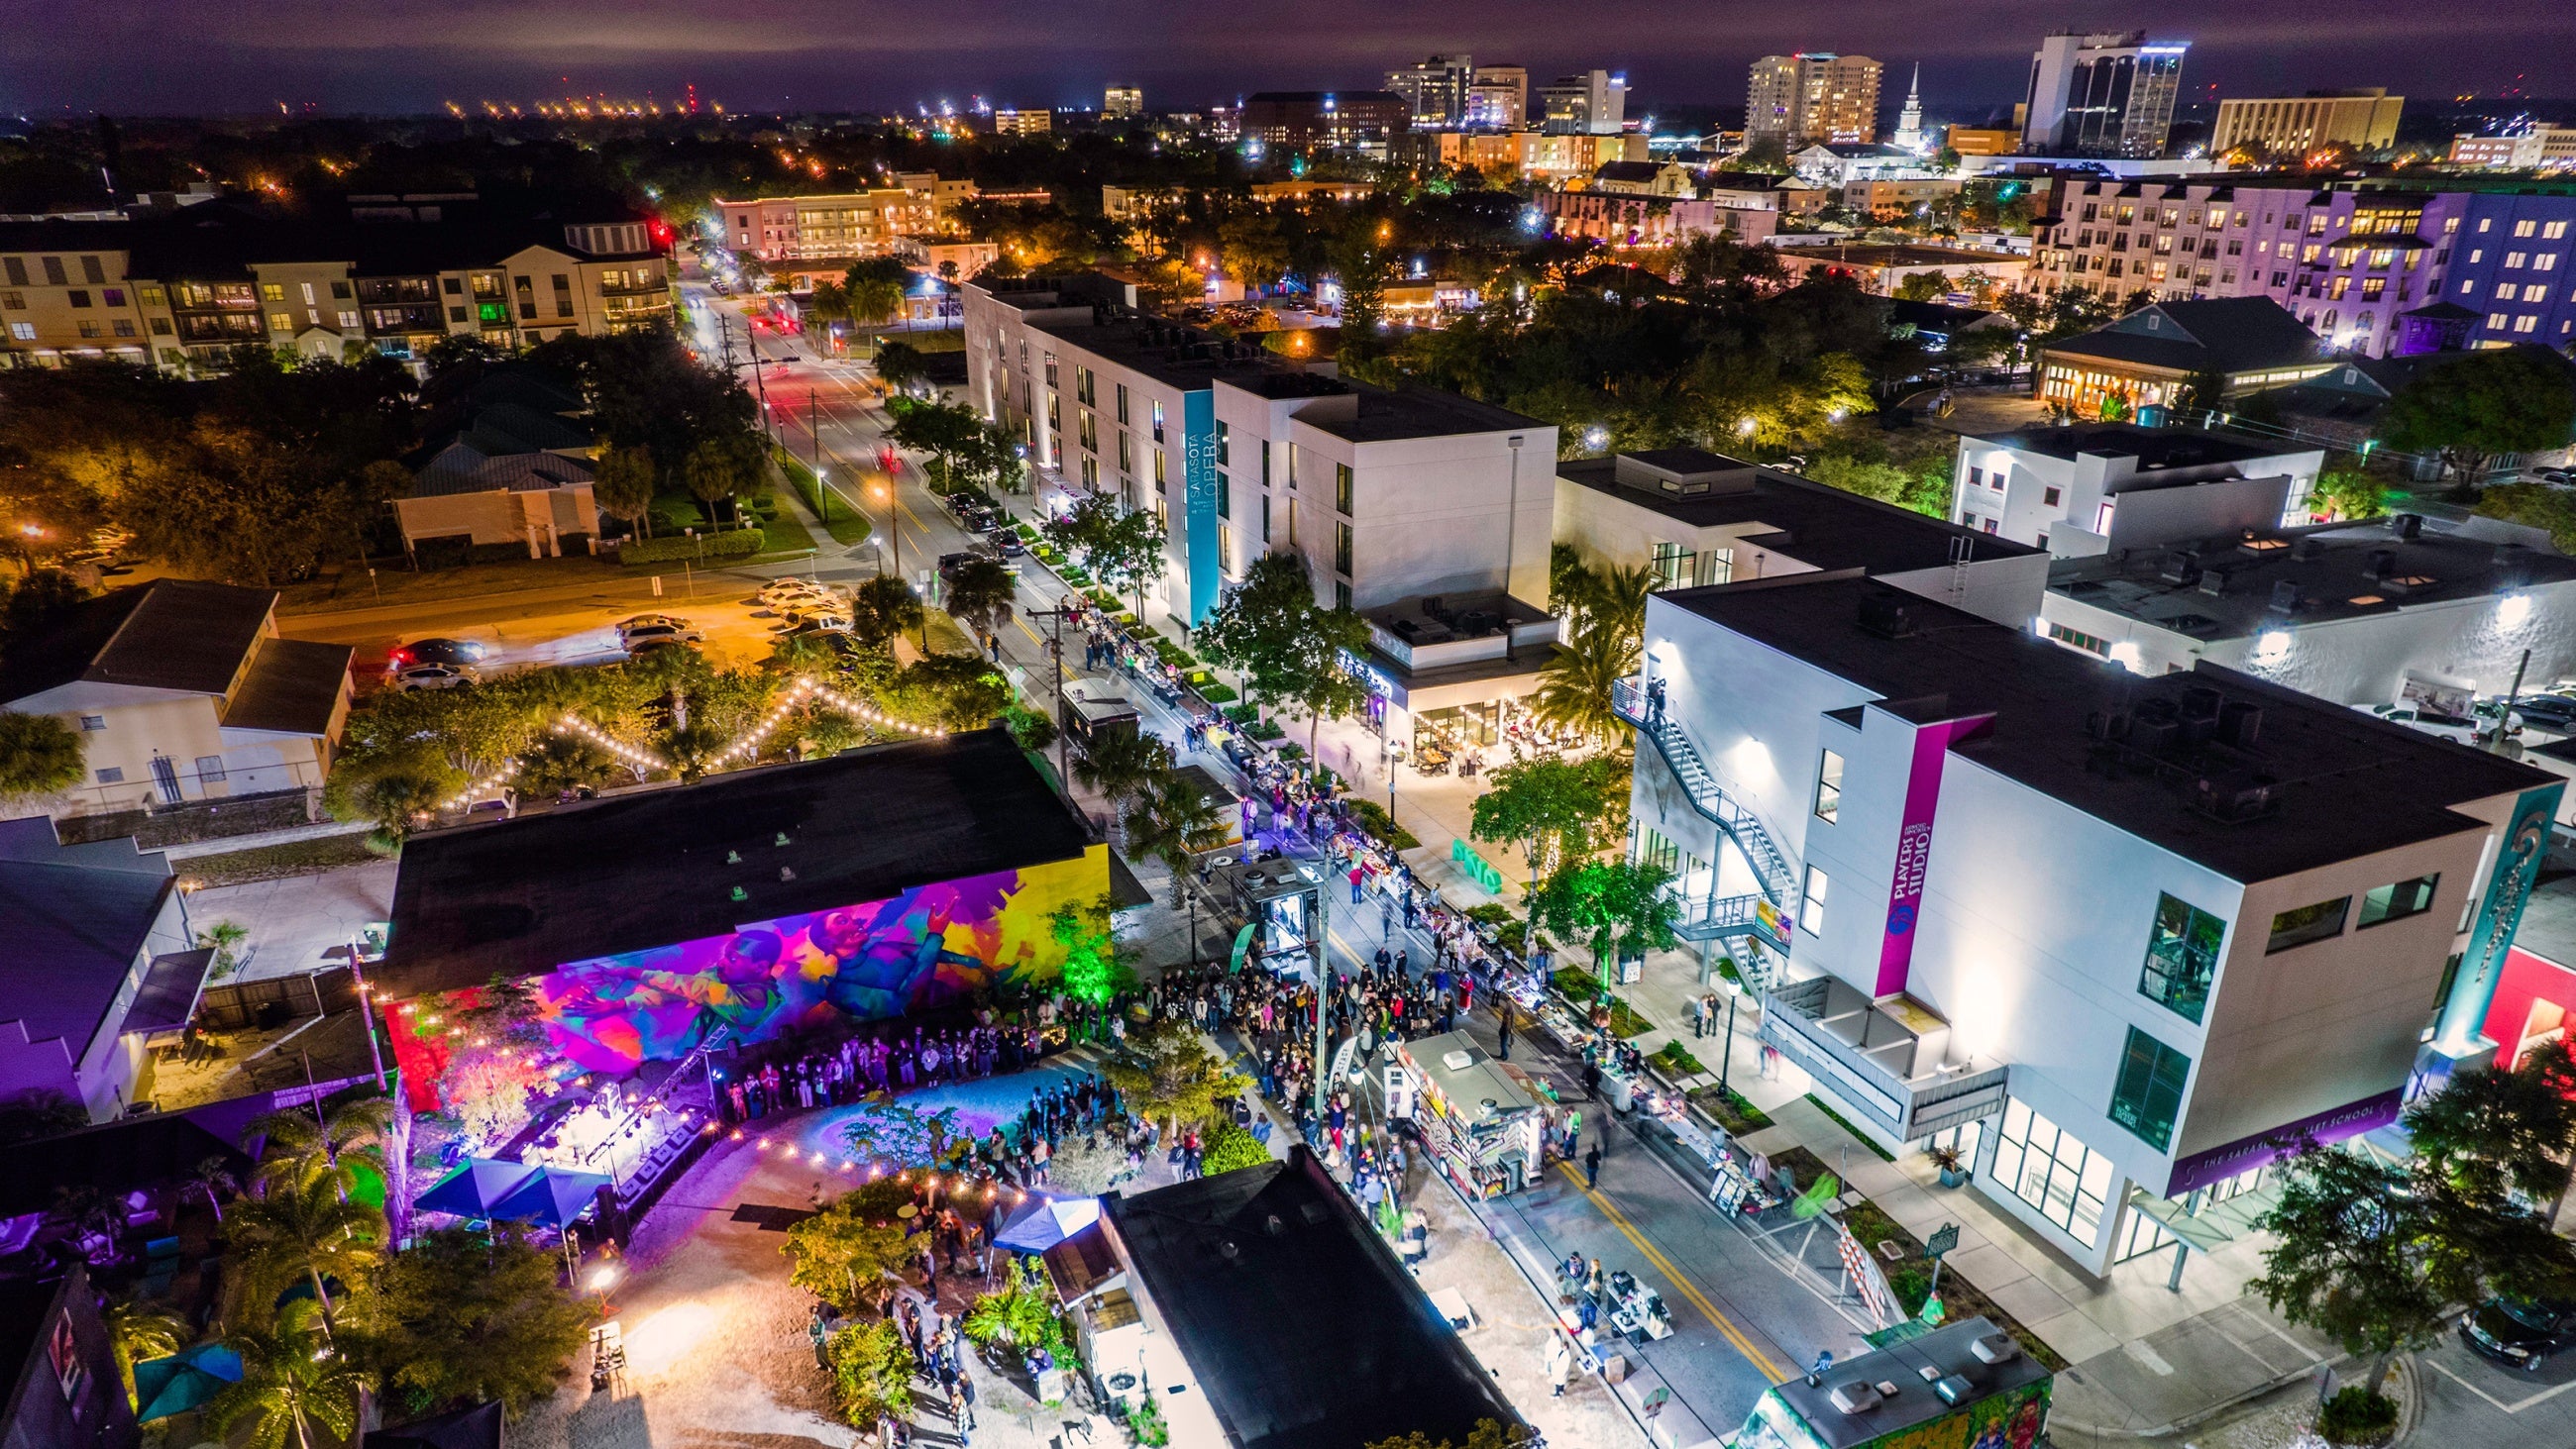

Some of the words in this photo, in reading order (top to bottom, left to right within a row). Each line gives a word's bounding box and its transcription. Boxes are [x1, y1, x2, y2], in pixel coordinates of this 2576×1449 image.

[1189, 434, 1200, 498] SARASOTA
[1203, 432, 1217, 496] OPERA
[1894, 837, 1913, 899] PLAYERS
[1908, 832, 1930, 896] STUDIO
[2203, 1155, 2222, 1170] THE
[2330, 1105, 2374, 1127] SCHOOL
